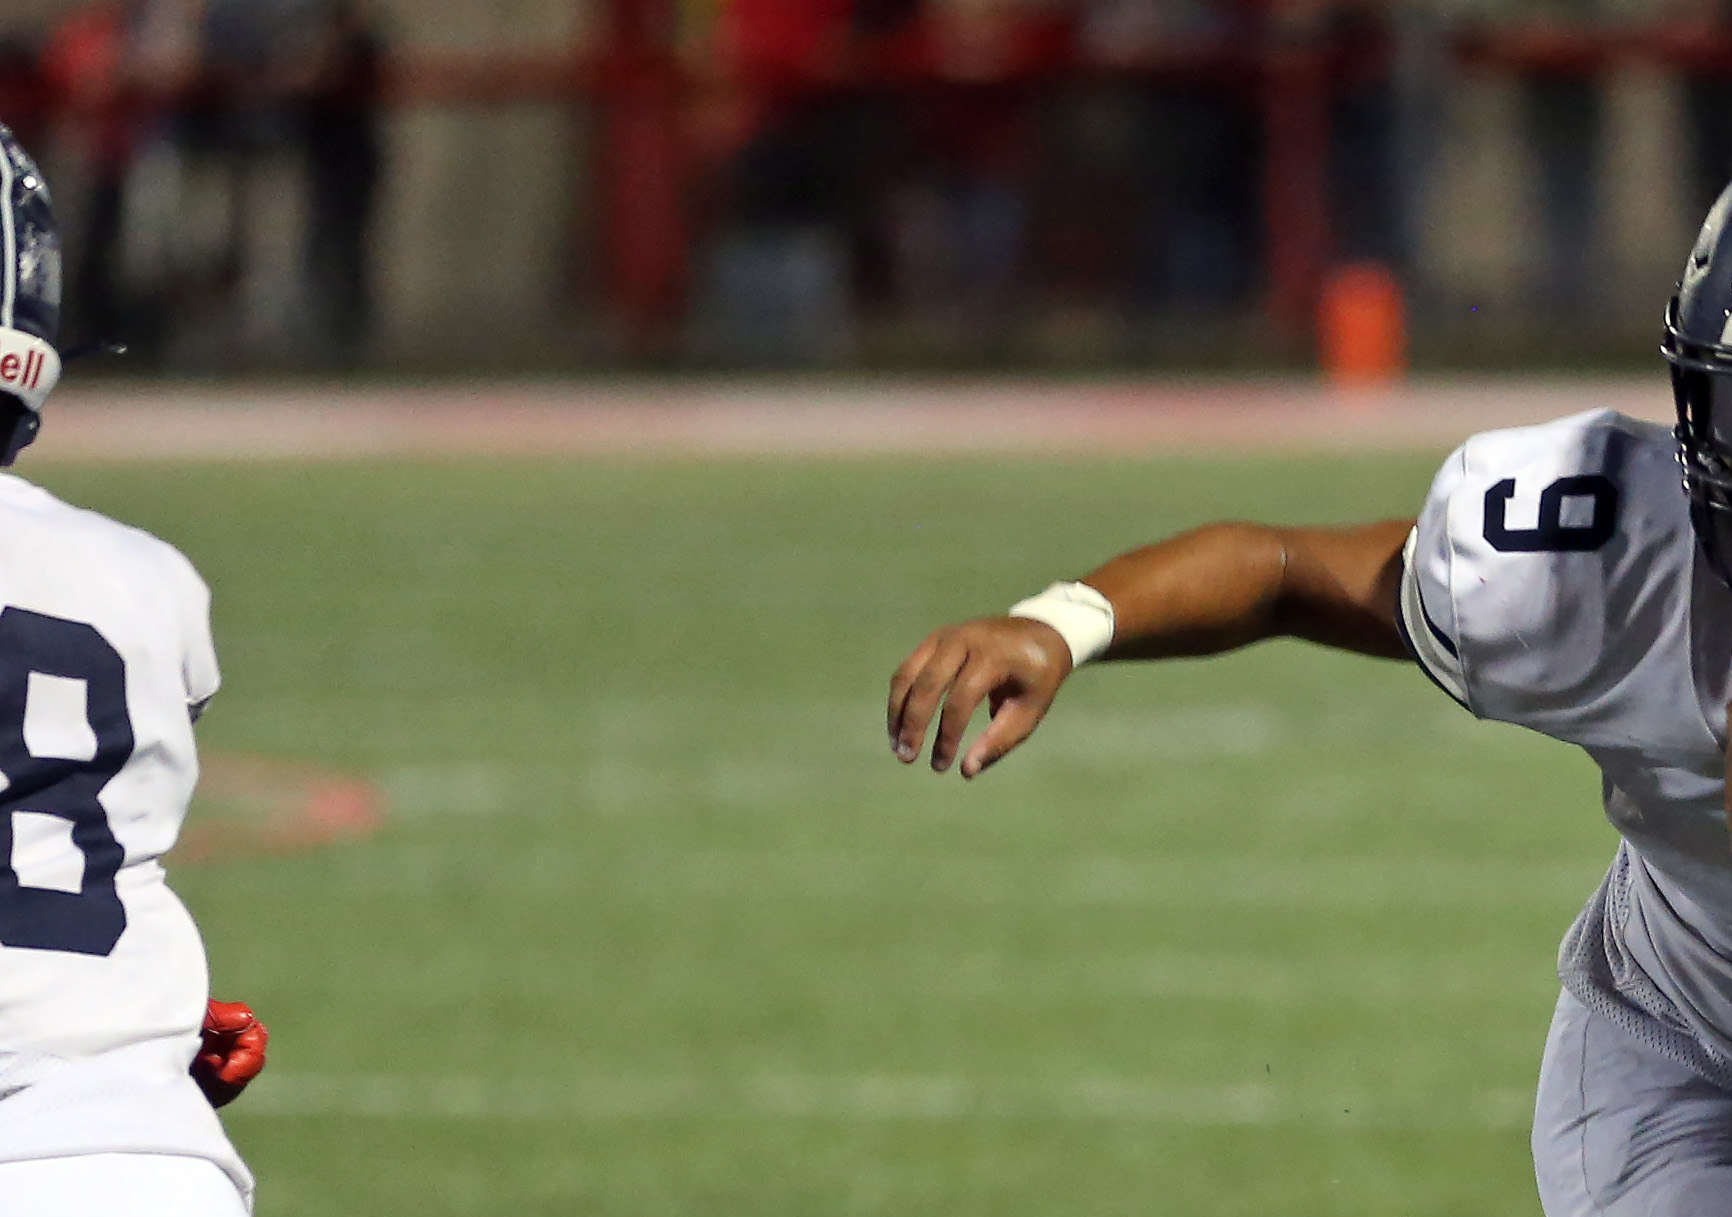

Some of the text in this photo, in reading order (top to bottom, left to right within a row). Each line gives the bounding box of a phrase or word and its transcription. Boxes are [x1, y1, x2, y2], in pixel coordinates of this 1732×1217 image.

[0, 350, 44, 389] ell
[1482, 474, 1618, 552] 9
[0, 605, 135, 957] 8
